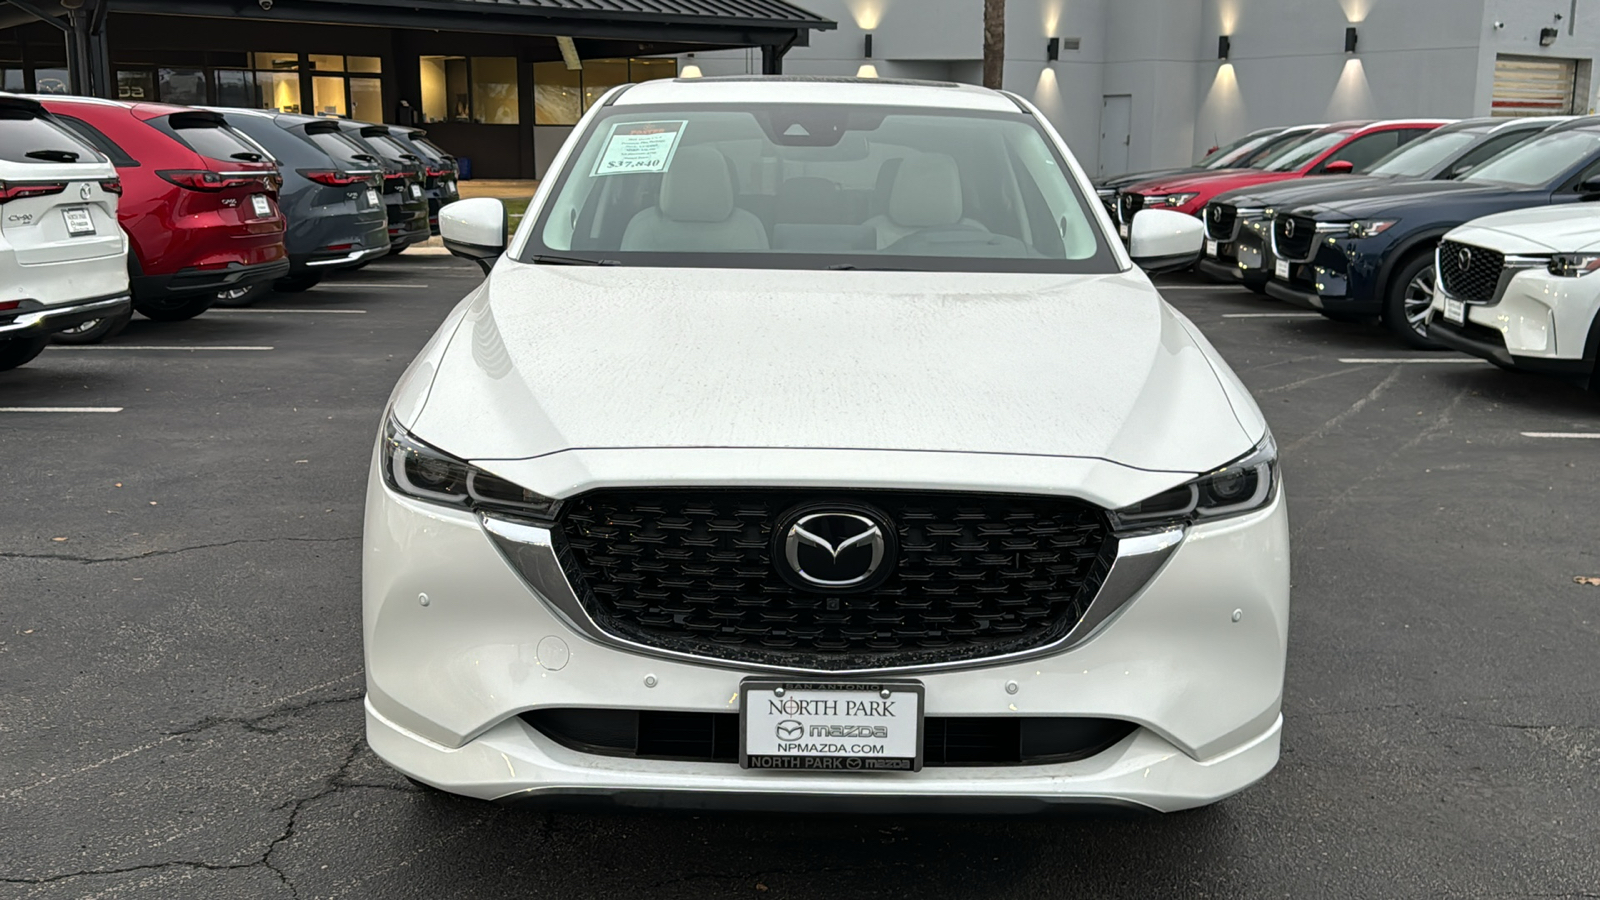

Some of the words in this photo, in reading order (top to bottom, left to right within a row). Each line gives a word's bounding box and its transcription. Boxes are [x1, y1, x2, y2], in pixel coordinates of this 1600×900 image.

[768, 698, 838, 717] NORTH
[845, 700, 896, 717] PARK
[777, 743, 884, 754] NPMAZDA.COM
[751, 756, 800, 768] NORTH
[804, 757, 842, 769] PARK
